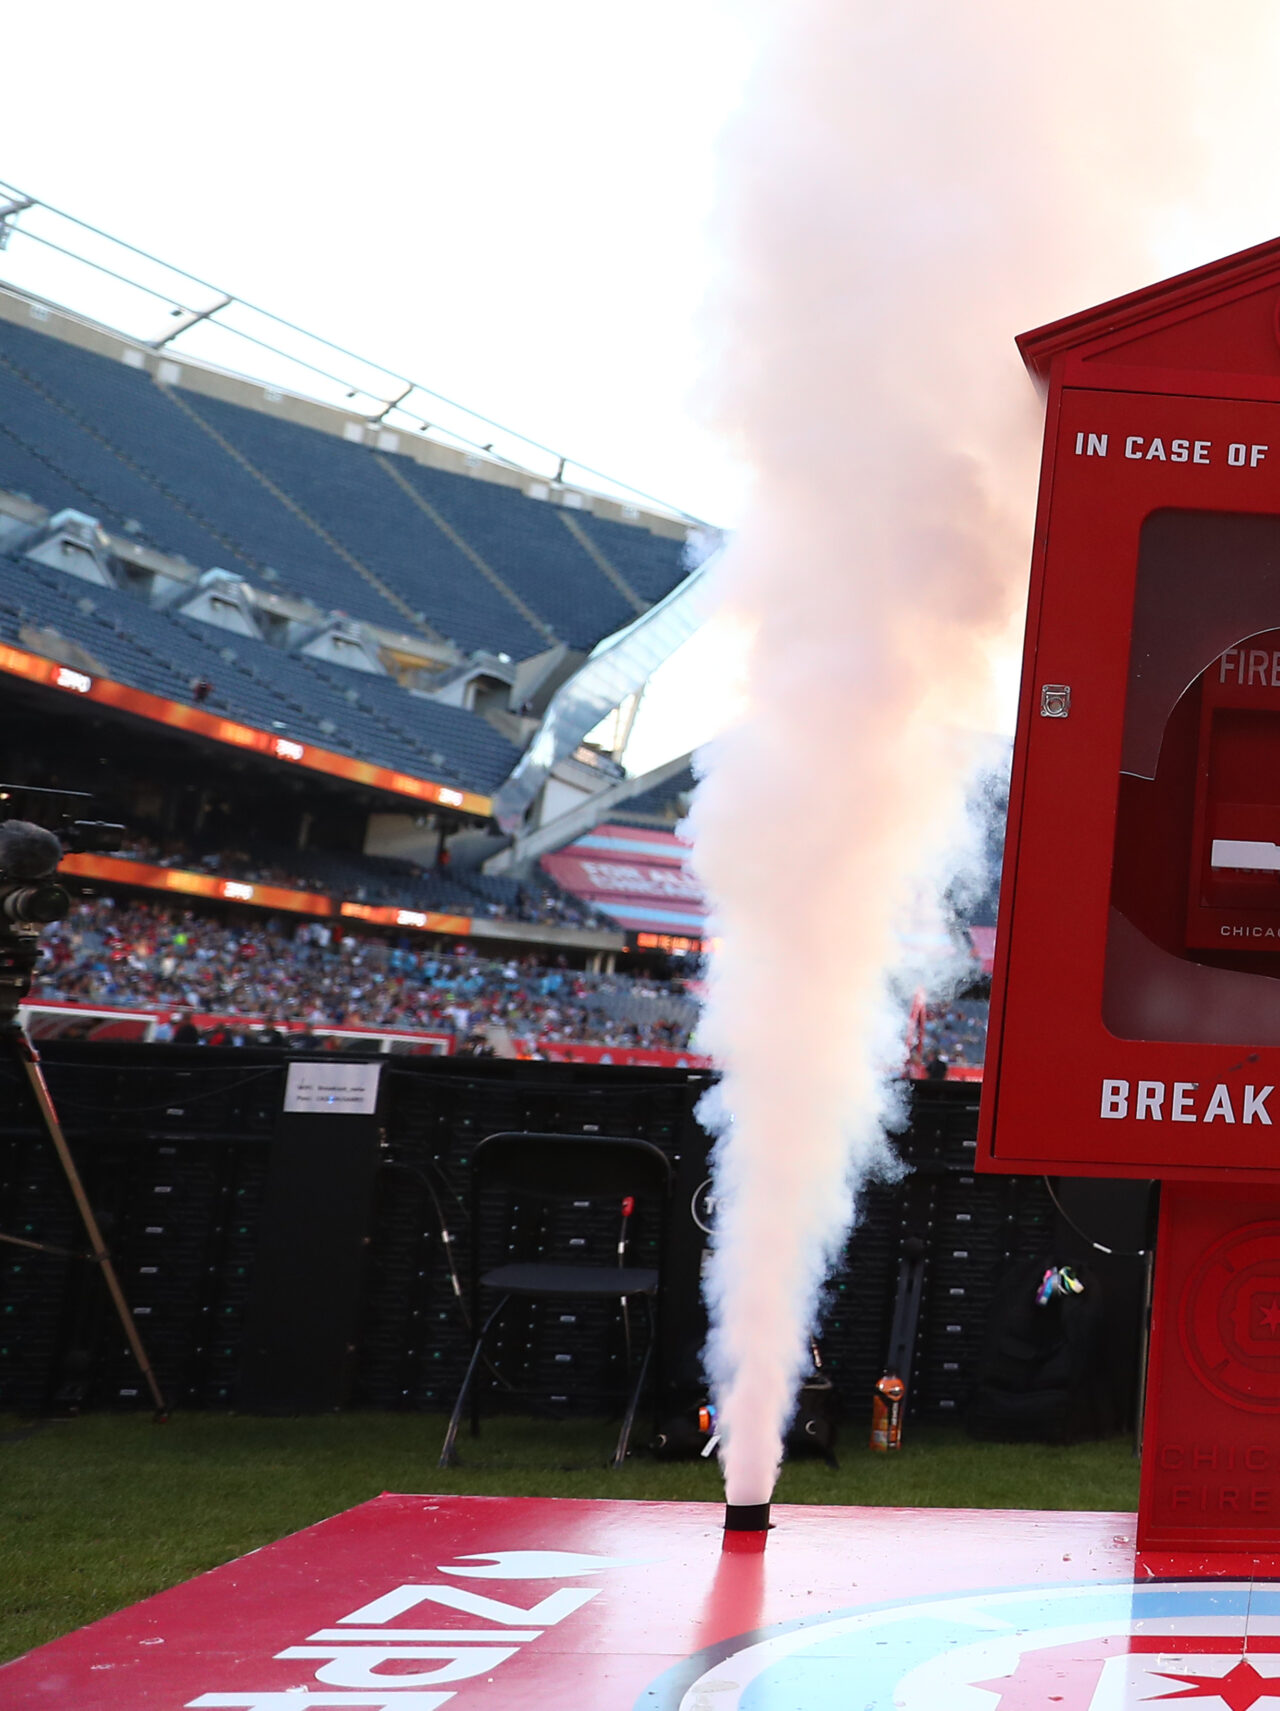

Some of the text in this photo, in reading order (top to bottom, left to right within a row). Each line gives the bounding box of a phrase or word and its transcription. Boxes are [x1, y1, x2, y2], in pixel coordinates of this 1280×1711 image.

[1075, 432, 1108, 457] IN
[1124, 436, 1212, 464] CASE
[1227, 443, 1269, 467] OF
[1100, 1079, 1275, 1125] BREAK
[1171, 1485, 1271, 1512] FIRE
